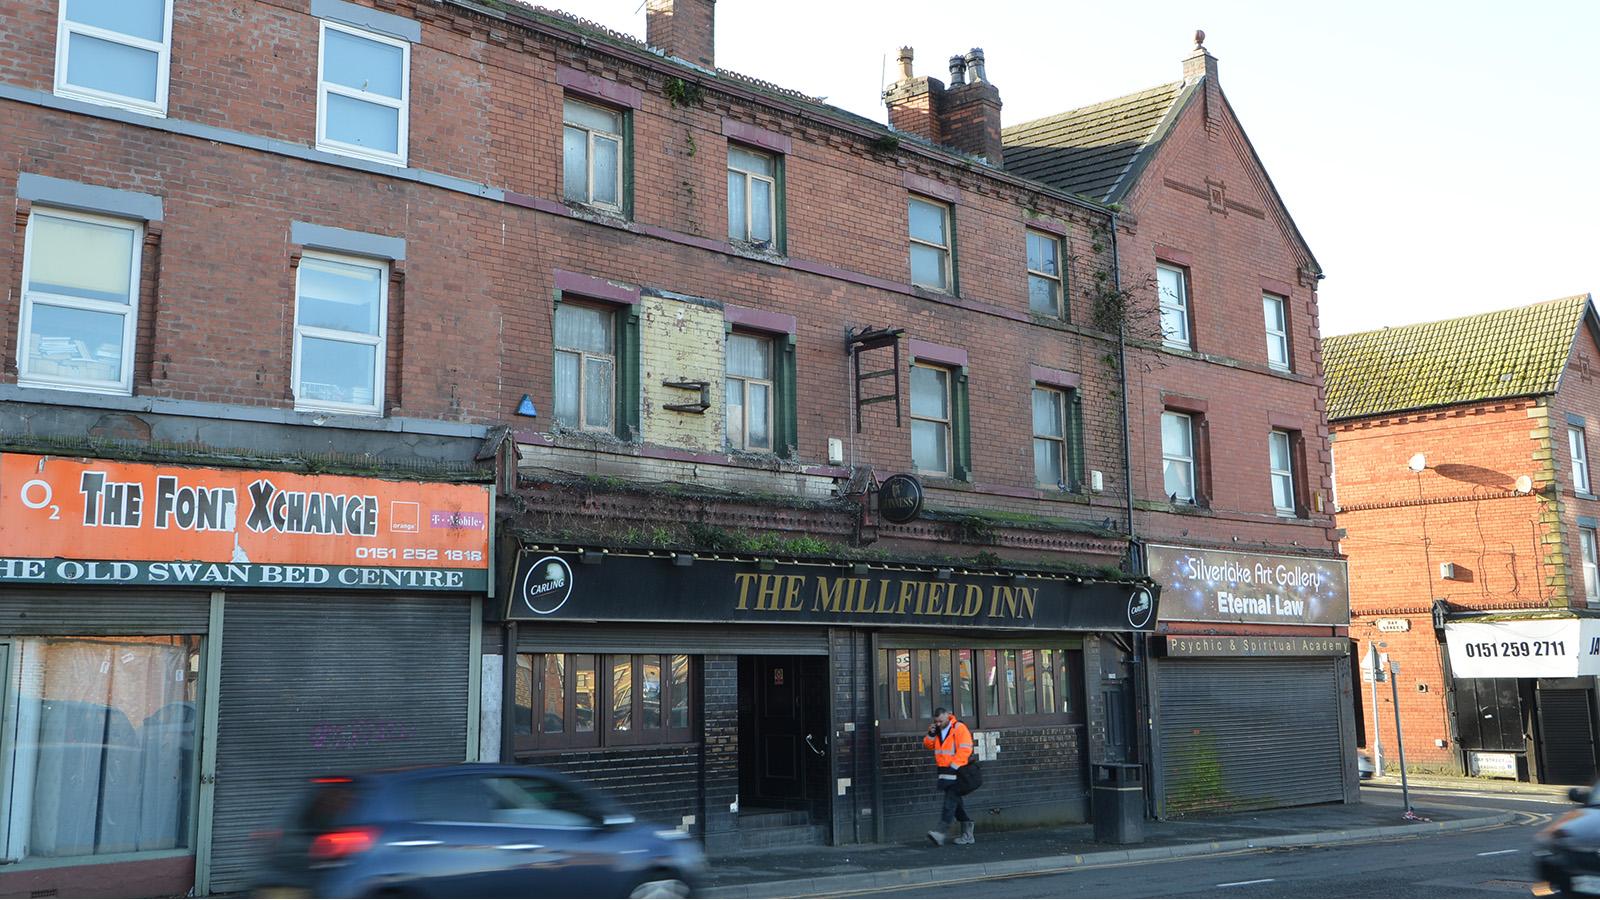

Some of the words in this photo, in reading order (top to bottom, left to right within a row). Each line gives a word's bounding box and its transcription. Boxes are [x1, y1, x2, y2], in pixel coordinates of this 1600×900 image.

[80, 470, 143, 528] THE
[246, 479, 379, 538] XCHANGE
[355, 547, 397, 560] 0151
[403, 548, 438, 560] 252
[444, 549, 482, 561] 1818
[56, 561, 139, 581] OLD
[148, 562, 252, 583] SWAN
[259, 565, 330, 585] BED
[337, 568, 464, 588] CENTRE
[530, 578, 565, 596] CARLING
[1188, 557, 1251, 584] Silverlake
[1254, 562, 1273, 585] Art
[1275, 564, 1321, 592] Gallery
[735, 573, 805, 611] THE
[811, 575, 983, 618] MILLFIELD
[988, 585, 1038, 620] INN
[1217, 591, 1272, 616] Eternal
[1275, 594, 1304, 617] Law
[1171, 639, 1222, 653] Psychic
[1229, 639, 1236, 650] &
[1243, 639, 1296, 652] Spiritual
[1302, 640, 1348, 654] Academy
[1465, 642, 1498, 658] 0151
[1501, 642, 1530, 657] 259
[1533, 641, 1566, 656] 2711
